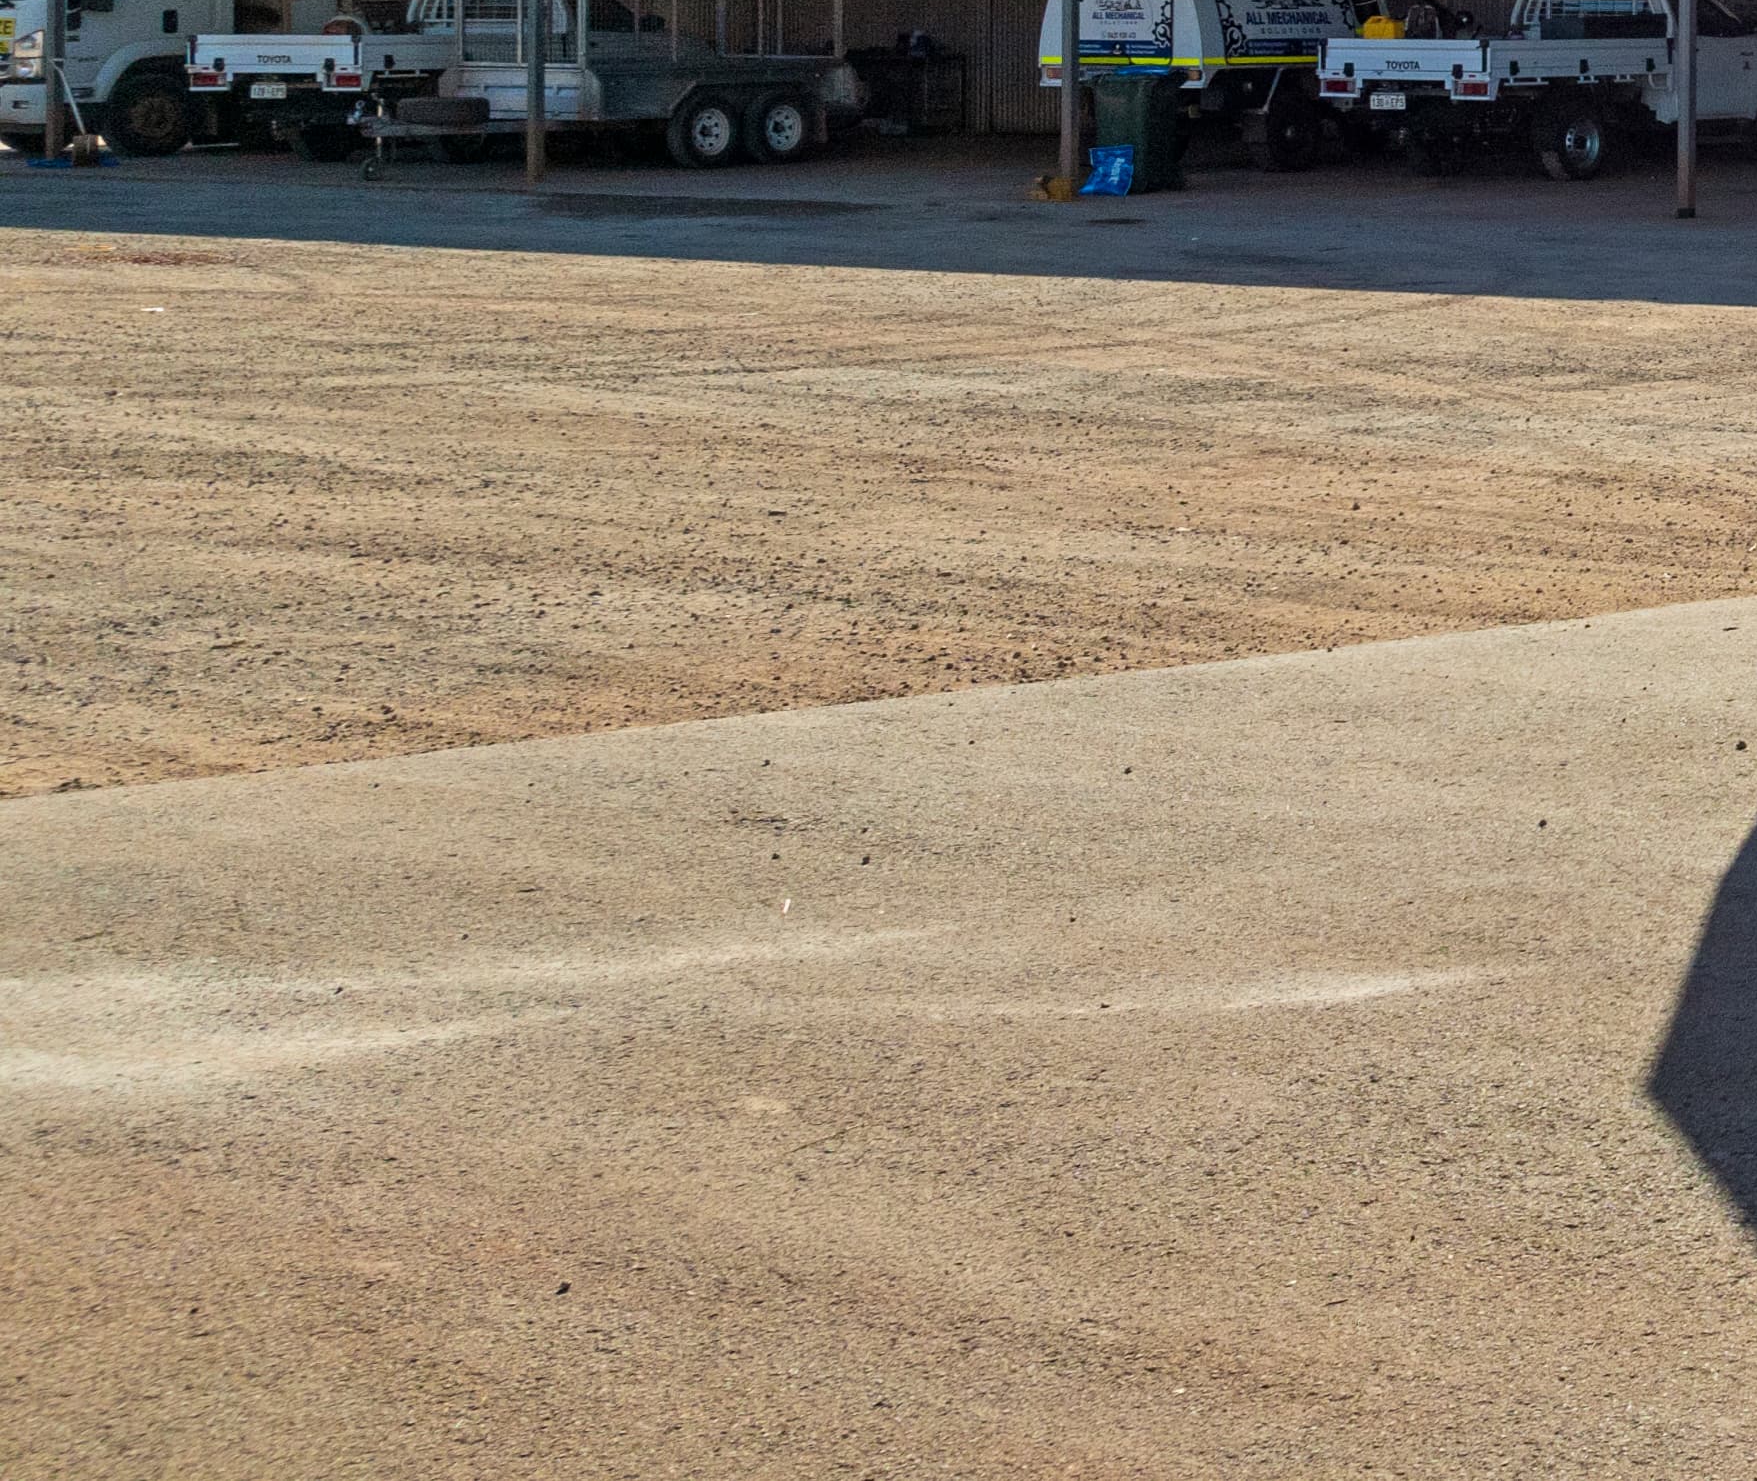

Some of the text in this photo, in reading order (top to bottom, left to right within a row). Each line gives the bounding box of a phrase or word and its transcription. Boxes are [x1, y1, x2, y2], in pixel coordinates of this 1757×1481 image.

[1246, 10, 1332, 25] ALL MECHANICAL
[257, 55, 292, 64] TOYOTA
[1385, 61, 1420, 70] TOYOTA
